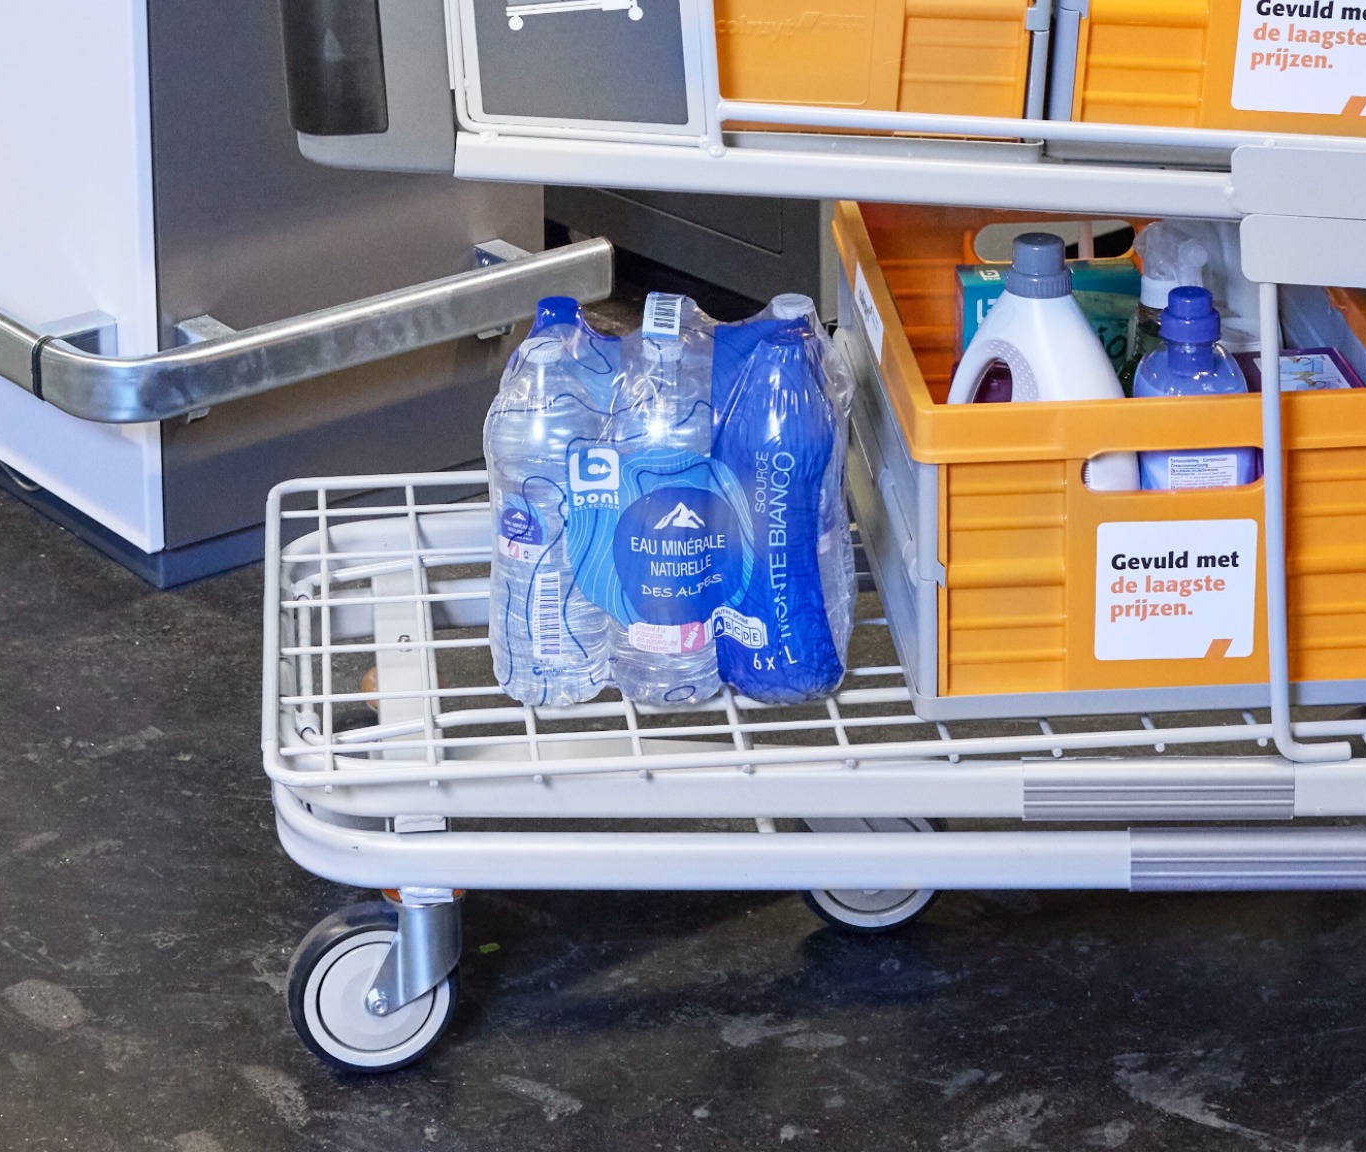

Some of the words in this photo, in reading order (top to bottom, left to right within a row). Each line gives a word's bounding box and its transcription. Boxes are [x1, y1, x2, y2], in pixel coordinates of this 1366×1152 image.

[1253, 22, 1281, 42] de
[1250, 48, 1334, 72] prijzen.
[755, 451, 769, 514] SOURCE
[572, 491, 619, 507] boni
[573, 503, 620, 511] SELECTION
[768, 451, 796, 547] BIANCO
[630, 536, 658, 555] EAU
[661, 534, 726, 557] MINÉRALE
[650, 554, 712, 577] NATURELLE
[1111, 550, 1189, 570] Gevuld
[1196, 550, 1240, 568] met
[641, 584, 674, 598] DES
[675, 573, 723, 598] ALPES
[1110, 576, 1138, 594] de
[1145, 575, 1226, 597] laagste
[1110, 599, 1193, 623] prijzen.
[715, 620, 724, 633] A
[753, 652, 763, 671] 6
[766, 656, 776, 671] x
